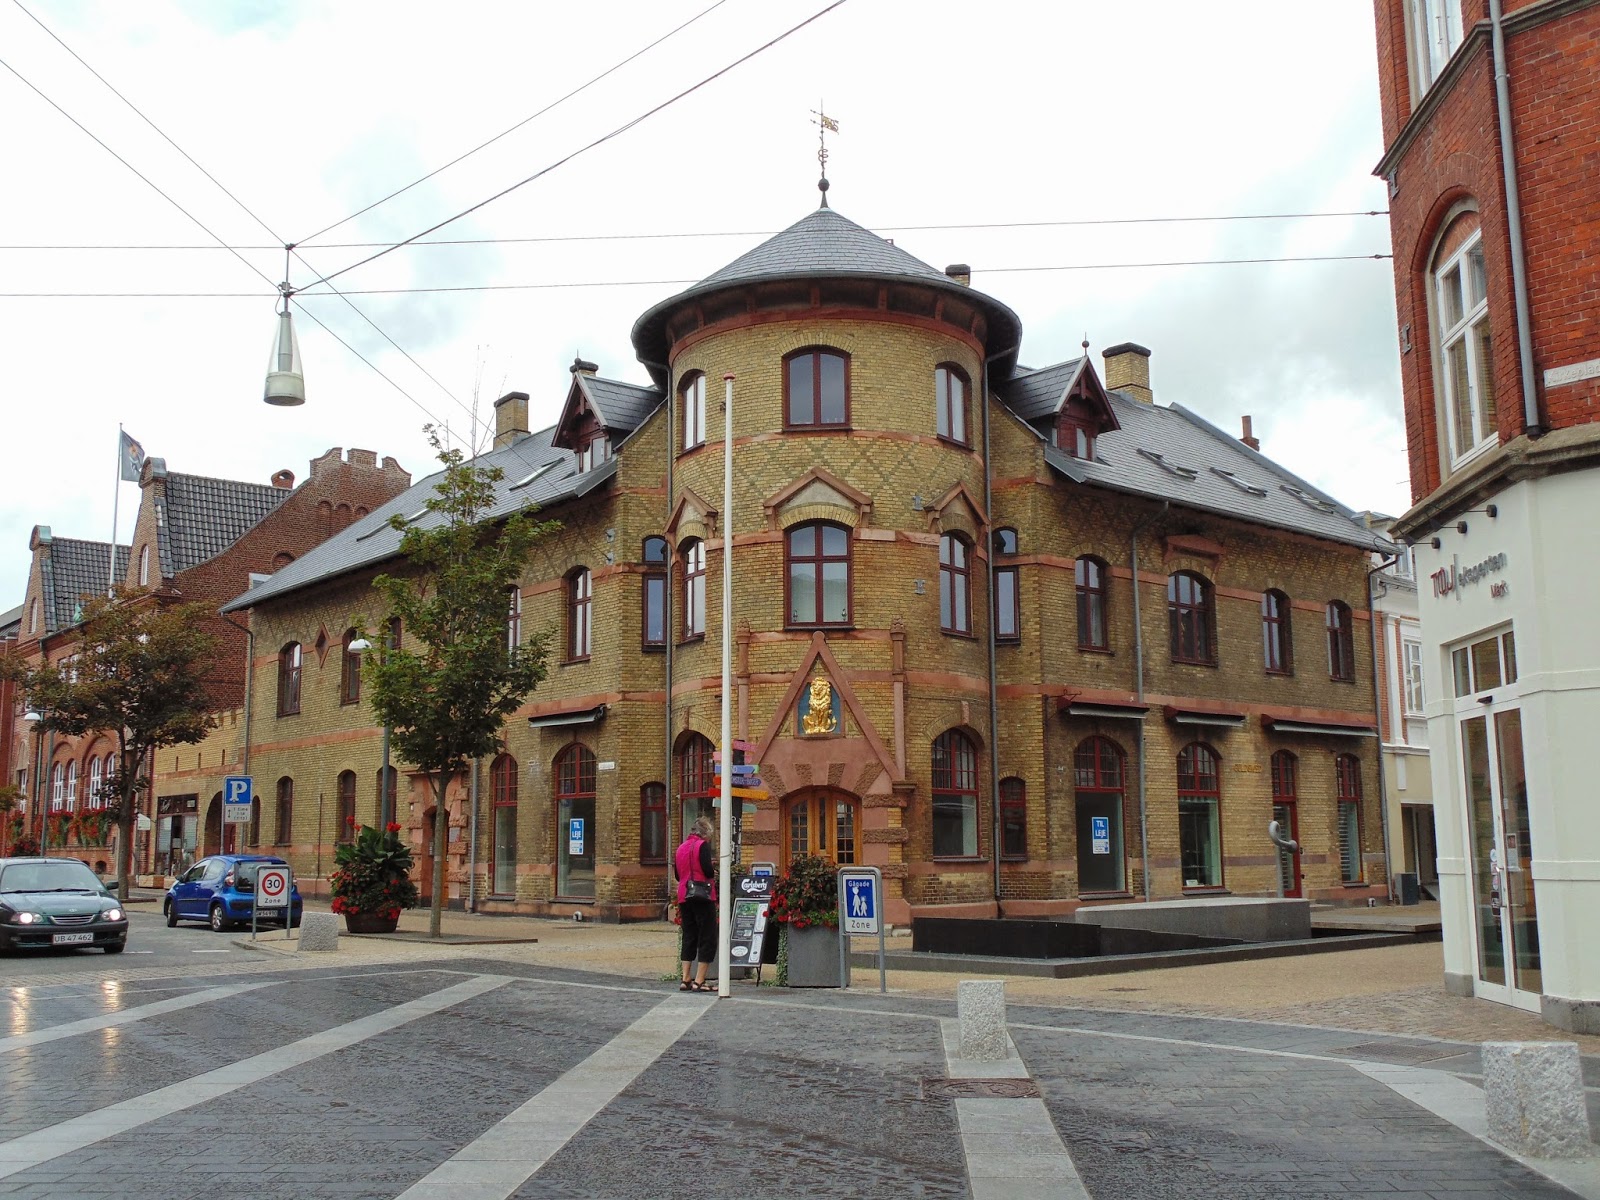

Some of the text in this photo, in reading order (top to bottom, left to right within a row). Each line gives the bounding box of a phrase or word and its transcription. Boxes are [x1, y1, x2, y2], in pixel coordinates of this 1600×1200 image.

[229, 780, 248, 802] P
[572, 821, 581, 829] TIL
[1095, 820, 1105, 828] TIL
[571, 830, 582, 840] LEJE
[1095, 829, 1107, 839] LEJE
[266, 879, 281, 889] 30
[741, 878, 769, 894] Carlsberg
[848, 880, 870, 889] Gågade
[851, 920, 871, 929] Zone
[54, 935, 66, 943] UB
